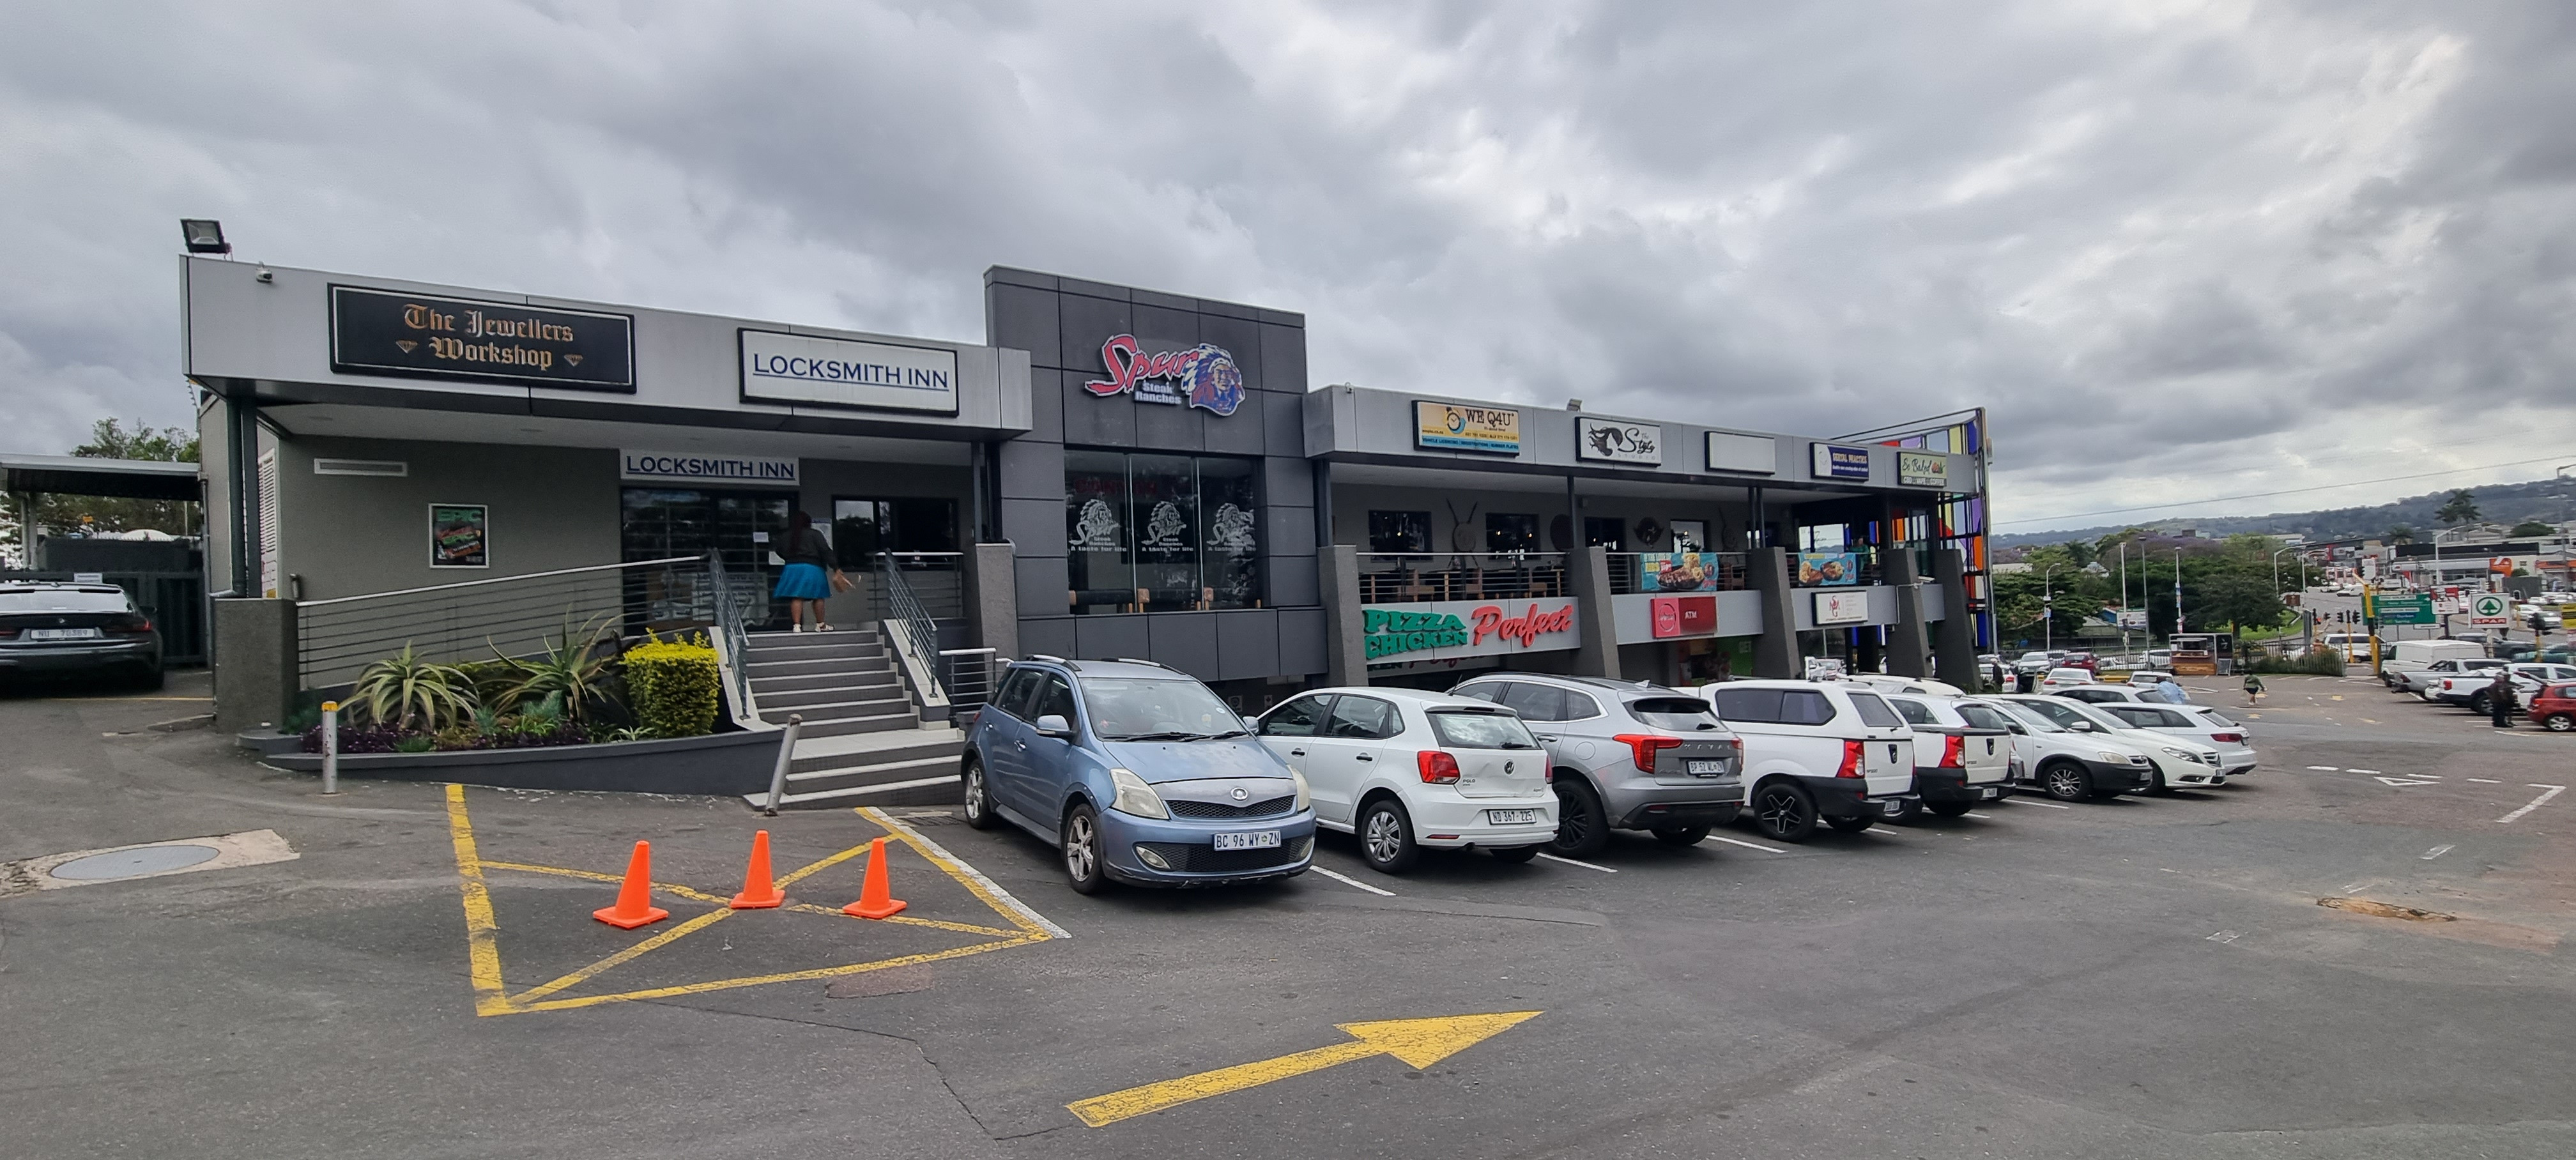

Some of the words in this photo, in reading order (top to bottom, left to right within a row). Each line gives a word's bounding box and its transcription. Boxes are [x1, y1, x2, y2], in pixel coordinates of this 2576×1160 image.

[404, 303, 456, 330] The
[464, 310, 574, 342] Jewellers
[429, 337, 553, 371] Workshop
[1085, 333, 1199, 396] Spur
[753, 353, 901, 384] LOCKSMITH
[908, 368, 949, 388] INN
[1135, 391, 1182, 405] Ranches
[1142, 381, 1173, 393] Steak
[1465, 409, 1484, 424] WE
[1618, 427, 1655, 454] Style
[626, 455, 753, 476] LOCKSMITH
[759, 462, 794, 477] INN
[1362, 609, 1466, 633] PIZZA
[1471, 603, 1574, 648] Perfect
[1685, 611, 1697, 619] ATM
[1364, 631, 1468, 660] CHICKEN
[1492, 812, 1501, 822] ND
[1216, 835, 1228, 848] BC
[1233, 835, 1245, 847] 96
[1249, 834, 1260, 846] WY
[1269, 832, 1280, 845] ZN
